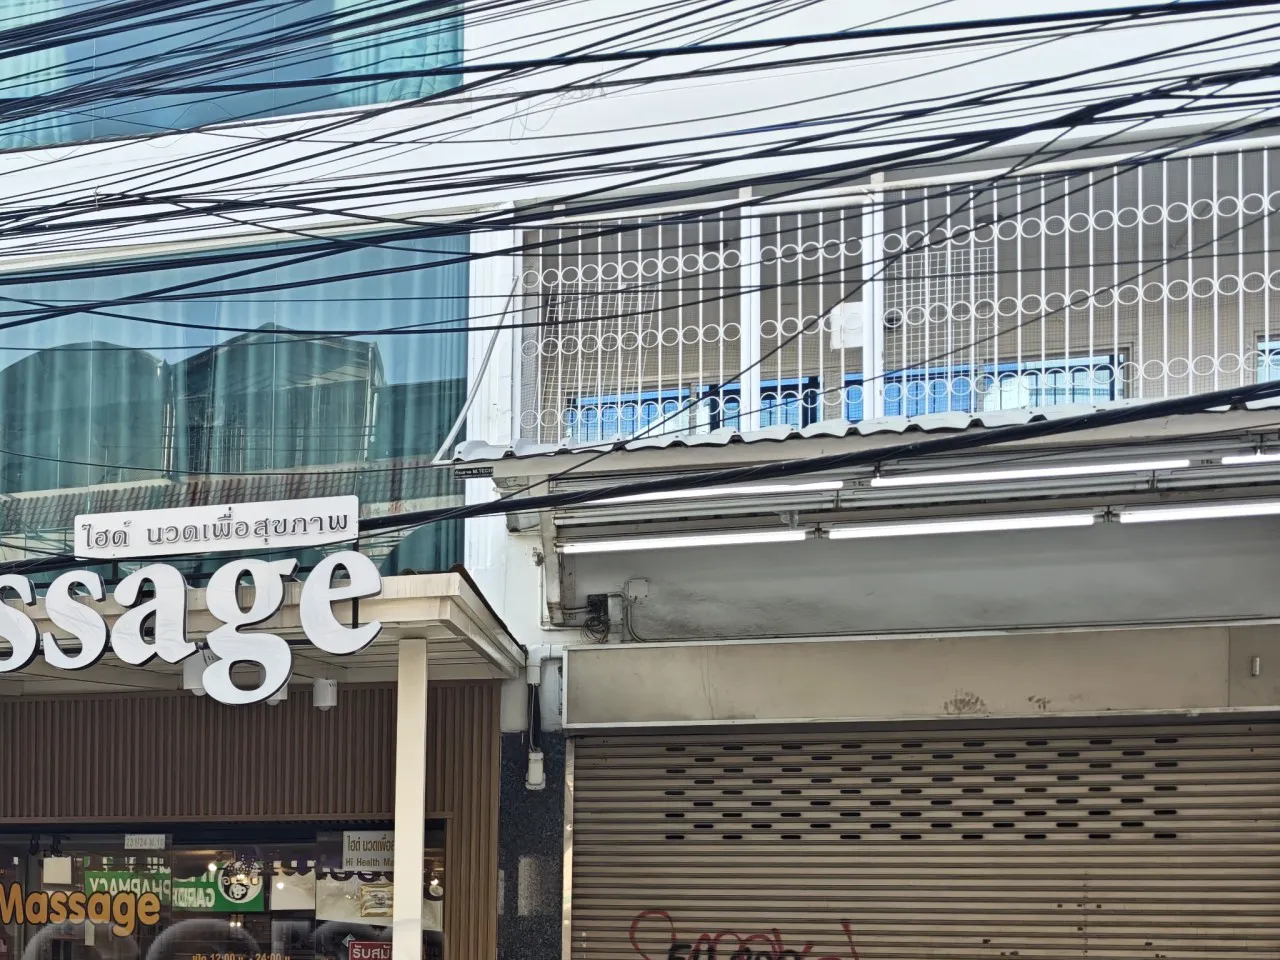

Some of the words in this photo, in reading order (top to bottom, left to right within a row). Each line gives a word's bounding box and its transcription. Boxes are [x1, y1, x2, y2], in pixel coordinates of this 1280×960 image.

[81, 518, 132, 549] ไฮด์
[146, 506, 349, 546] นวดเพื่อสุขภาพ
[345, 857, 353, 866] Hi
[356, 857, 380, 867] Health
